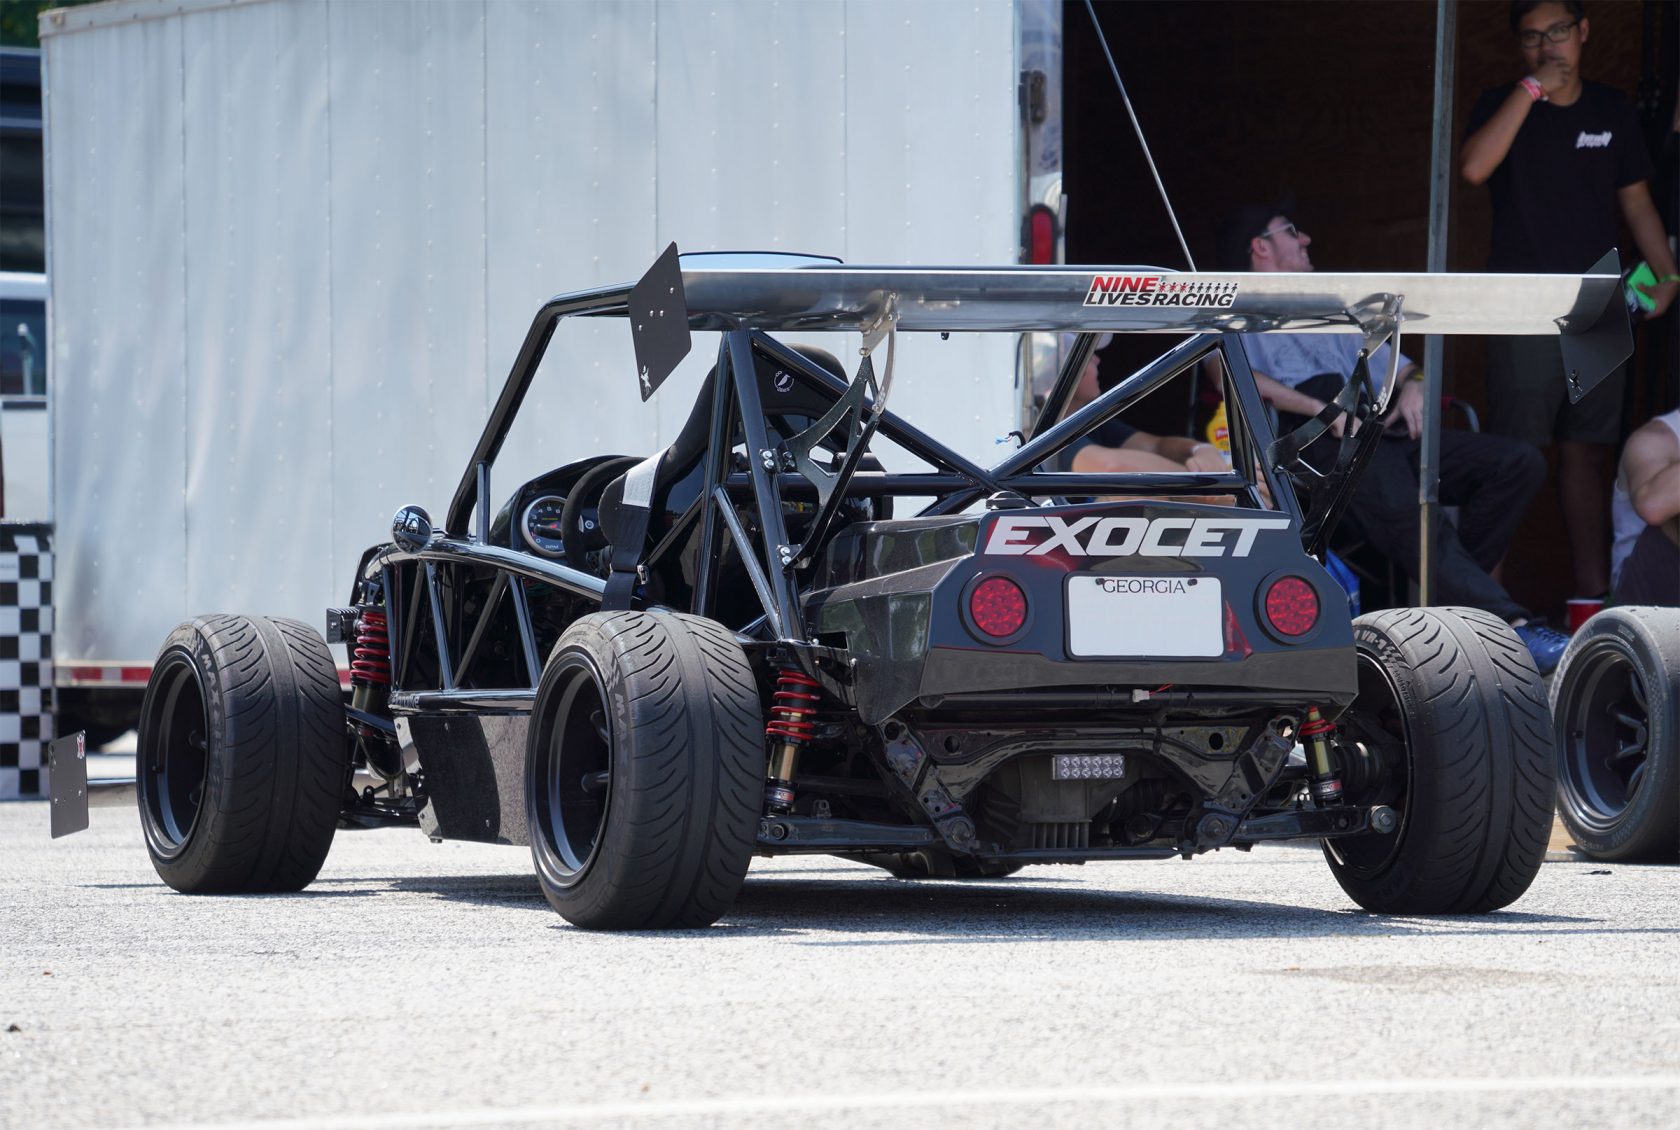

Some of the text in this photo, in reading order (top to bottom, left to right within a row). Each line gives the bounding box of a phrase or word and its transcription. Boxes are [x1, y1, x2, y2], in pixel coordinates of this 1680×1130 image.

[1090, 276, 1160, 293] NINE
[983, 515, 1292, 558] EXOCET
[1102, 578, 1187, 595] GEORGIA
